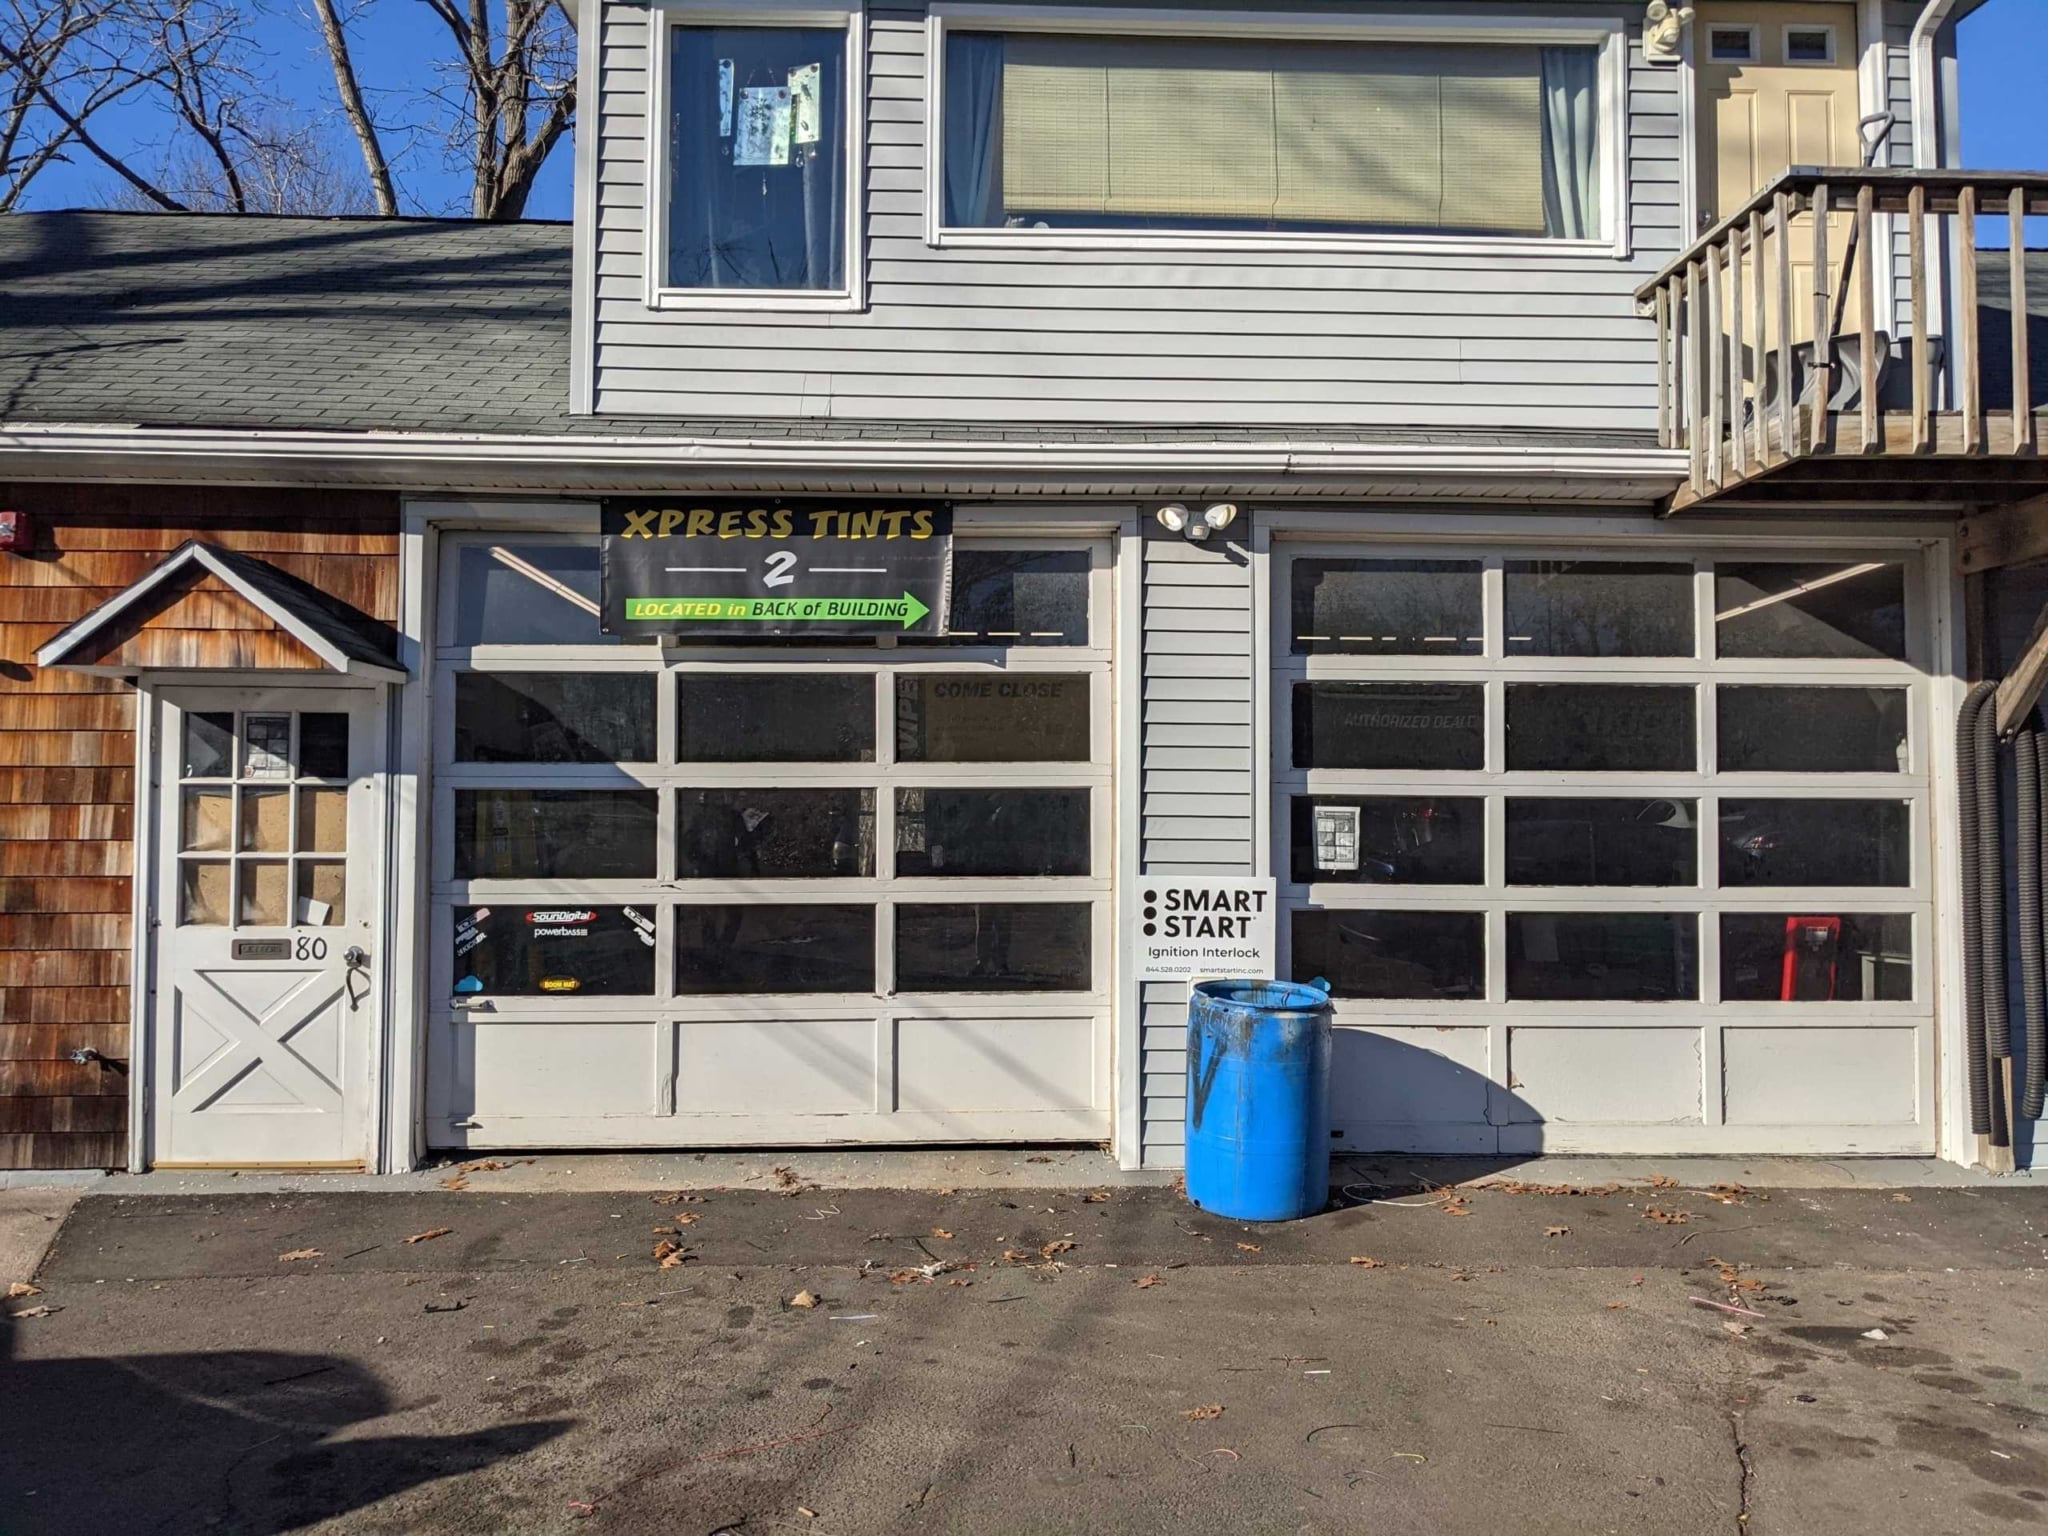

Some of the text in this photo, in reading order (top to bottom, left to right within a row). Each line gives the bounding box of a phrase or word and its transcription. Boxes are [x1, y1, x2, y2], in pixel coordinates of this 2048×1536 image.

[621, 509, 934, 540] XPRESS TINTS
[762, 550, 798, 588] 2
[634, 601, 909, 618] LOCATED in BACK of BUILDING
[933, 682, 1064, 698] COME CLOSE
[1344, 711, 1431, 729] AUTHORIZED
[1164, 889, 1267, 912] SMART
[1164, 915, 1252, 938] START
[295, 936, 327, 961] 80
[1148, 946, 1261, 959] Ignition Interlock
[1199, 966, 1264, 975] smartstartinc.com
